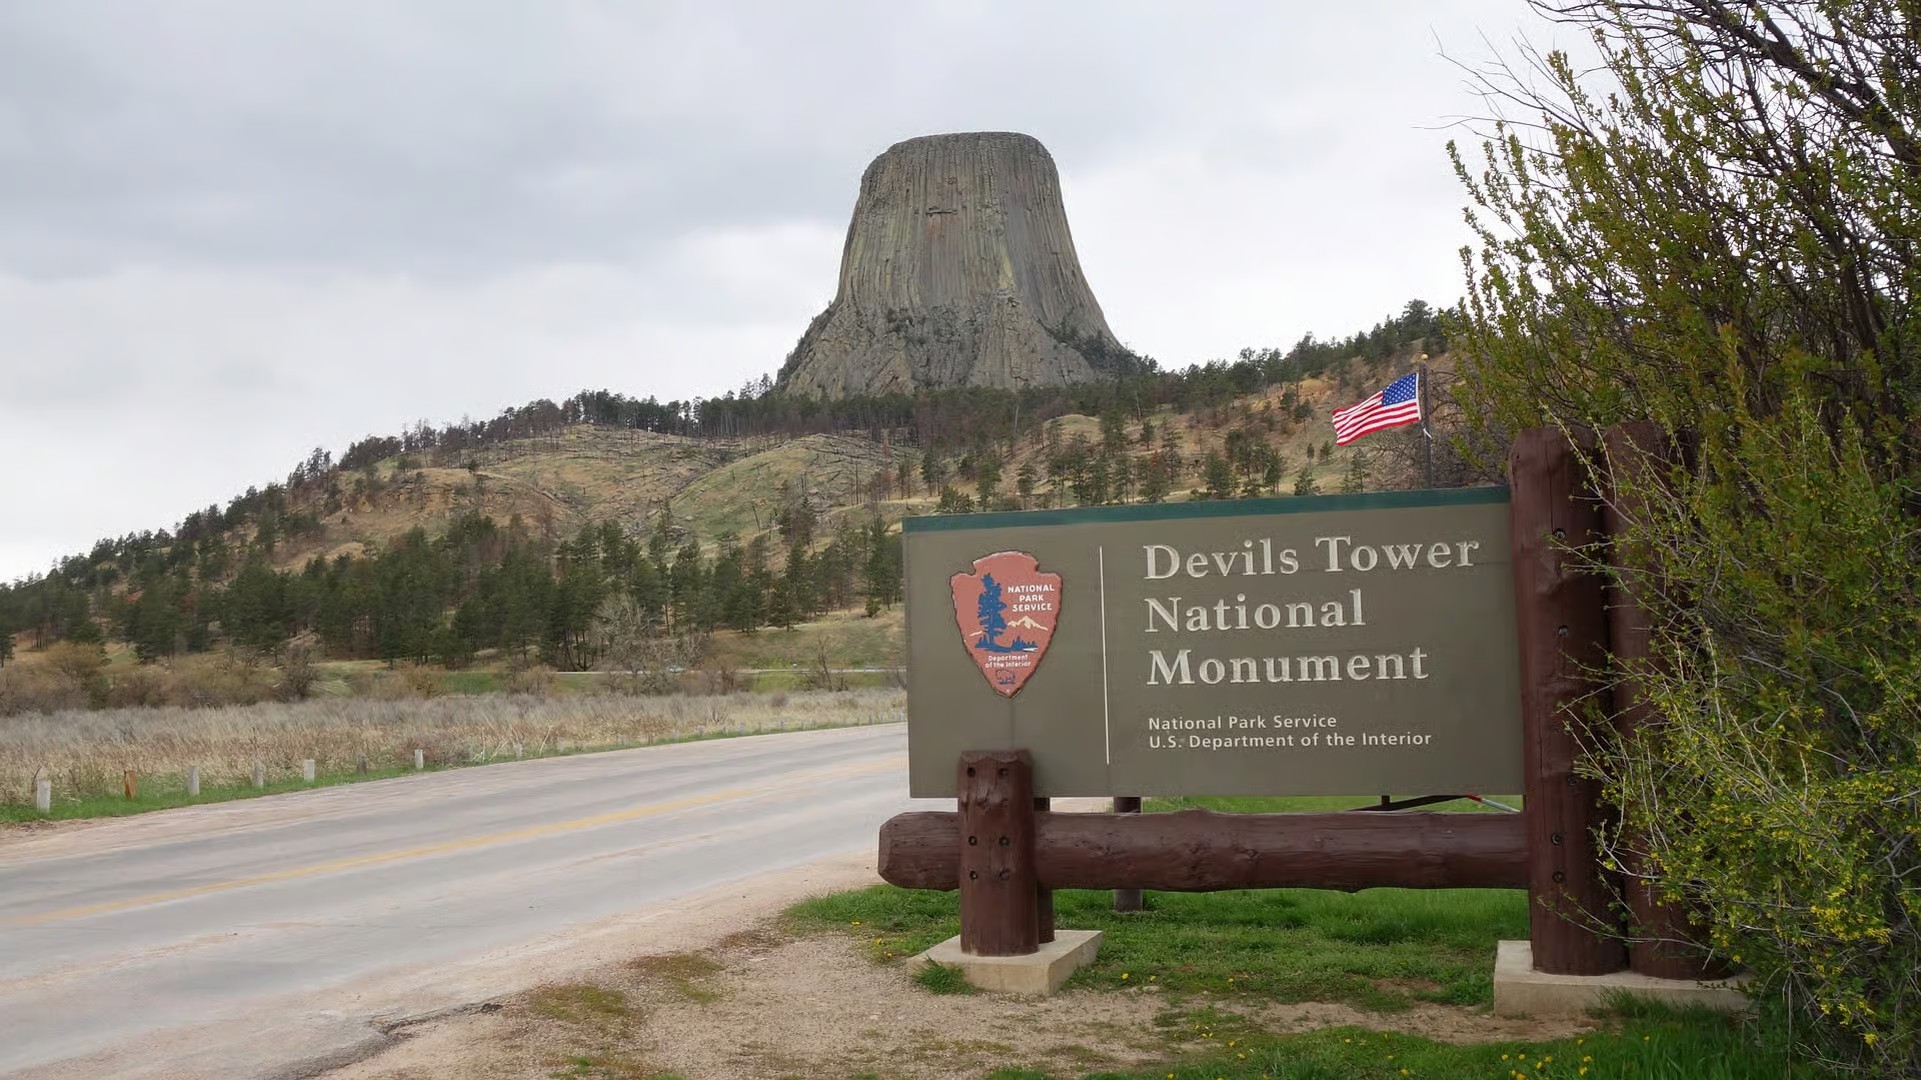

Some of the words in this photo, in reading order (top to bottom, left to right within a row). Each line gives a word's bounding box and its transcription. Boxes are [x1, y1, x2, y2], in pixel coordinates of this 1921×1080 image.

[1142, 537, 1299, 580] Devils
[1315, 535, 1479, 572] Tower
[1008, 584, 1055, 593] NATIONAL
[1012, 604, 1052, 612] SERVICE
[1144, 588, 1366, 633] National
[988, 654, 1028, 662] Department
[1146, 647, 1429, 685] Monument
[1148, 715, 1222, 731] National
[1228, 714, 1267, 729] Park
[1273, 713, 1337, 729] Service
[1149, 735, 1182, 749] U.S.
[1189, 734, 1294, 751] Department
[1300, 732, 1319, 747] of
[1325, 732, 1355, 747] the
[1362, 731, 1432, 746] Interior
